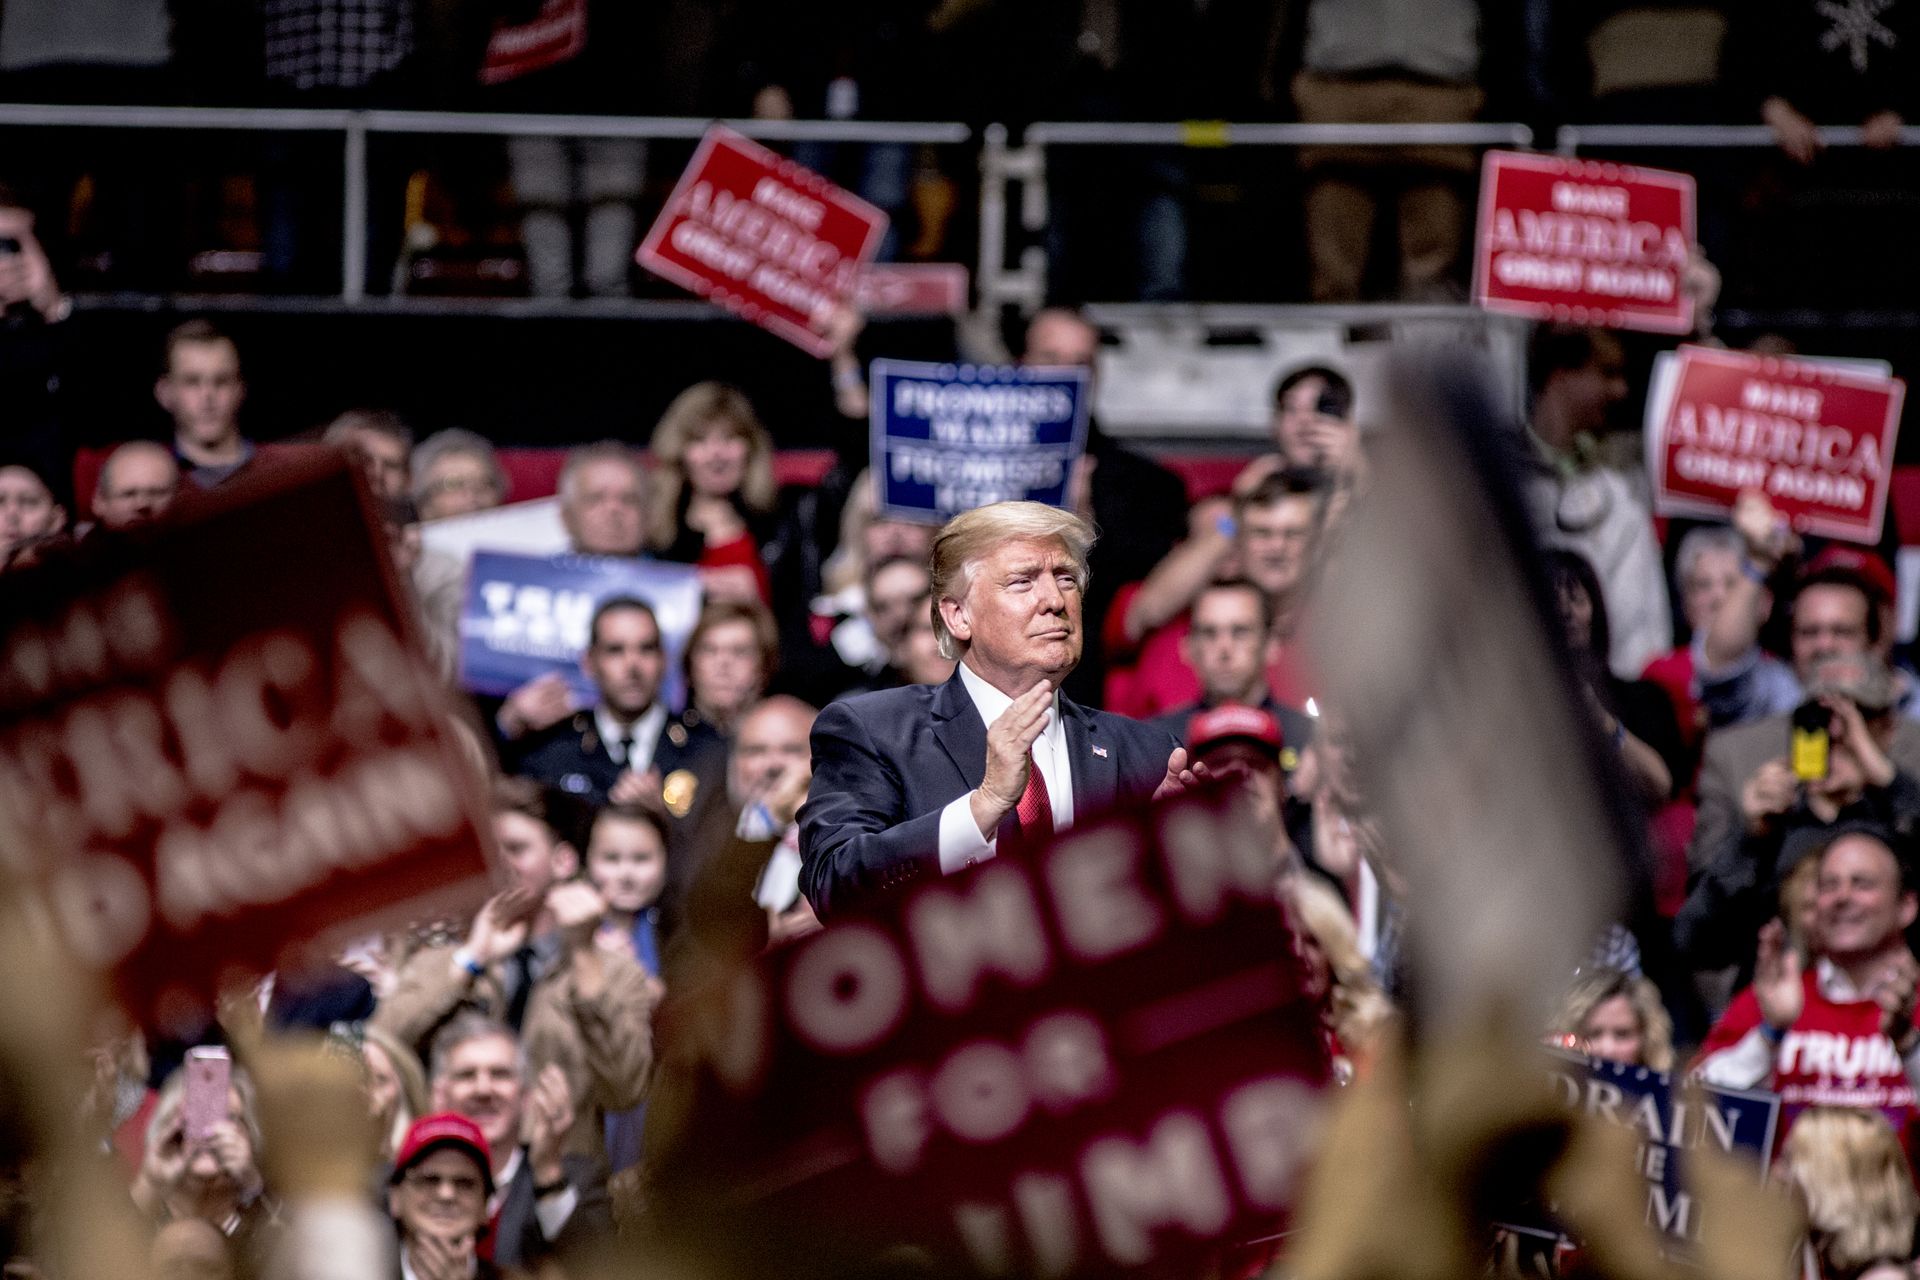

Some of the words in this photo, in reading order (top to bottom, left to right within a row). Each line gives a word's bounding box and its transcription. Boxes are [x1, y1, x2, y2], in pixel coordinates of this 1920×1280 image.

[1492, 207, 1688, 268] AMERICA
[1676, 401, 1881, 472] AMERICA
[1778, 1030, 1903, 1078] TRUM
